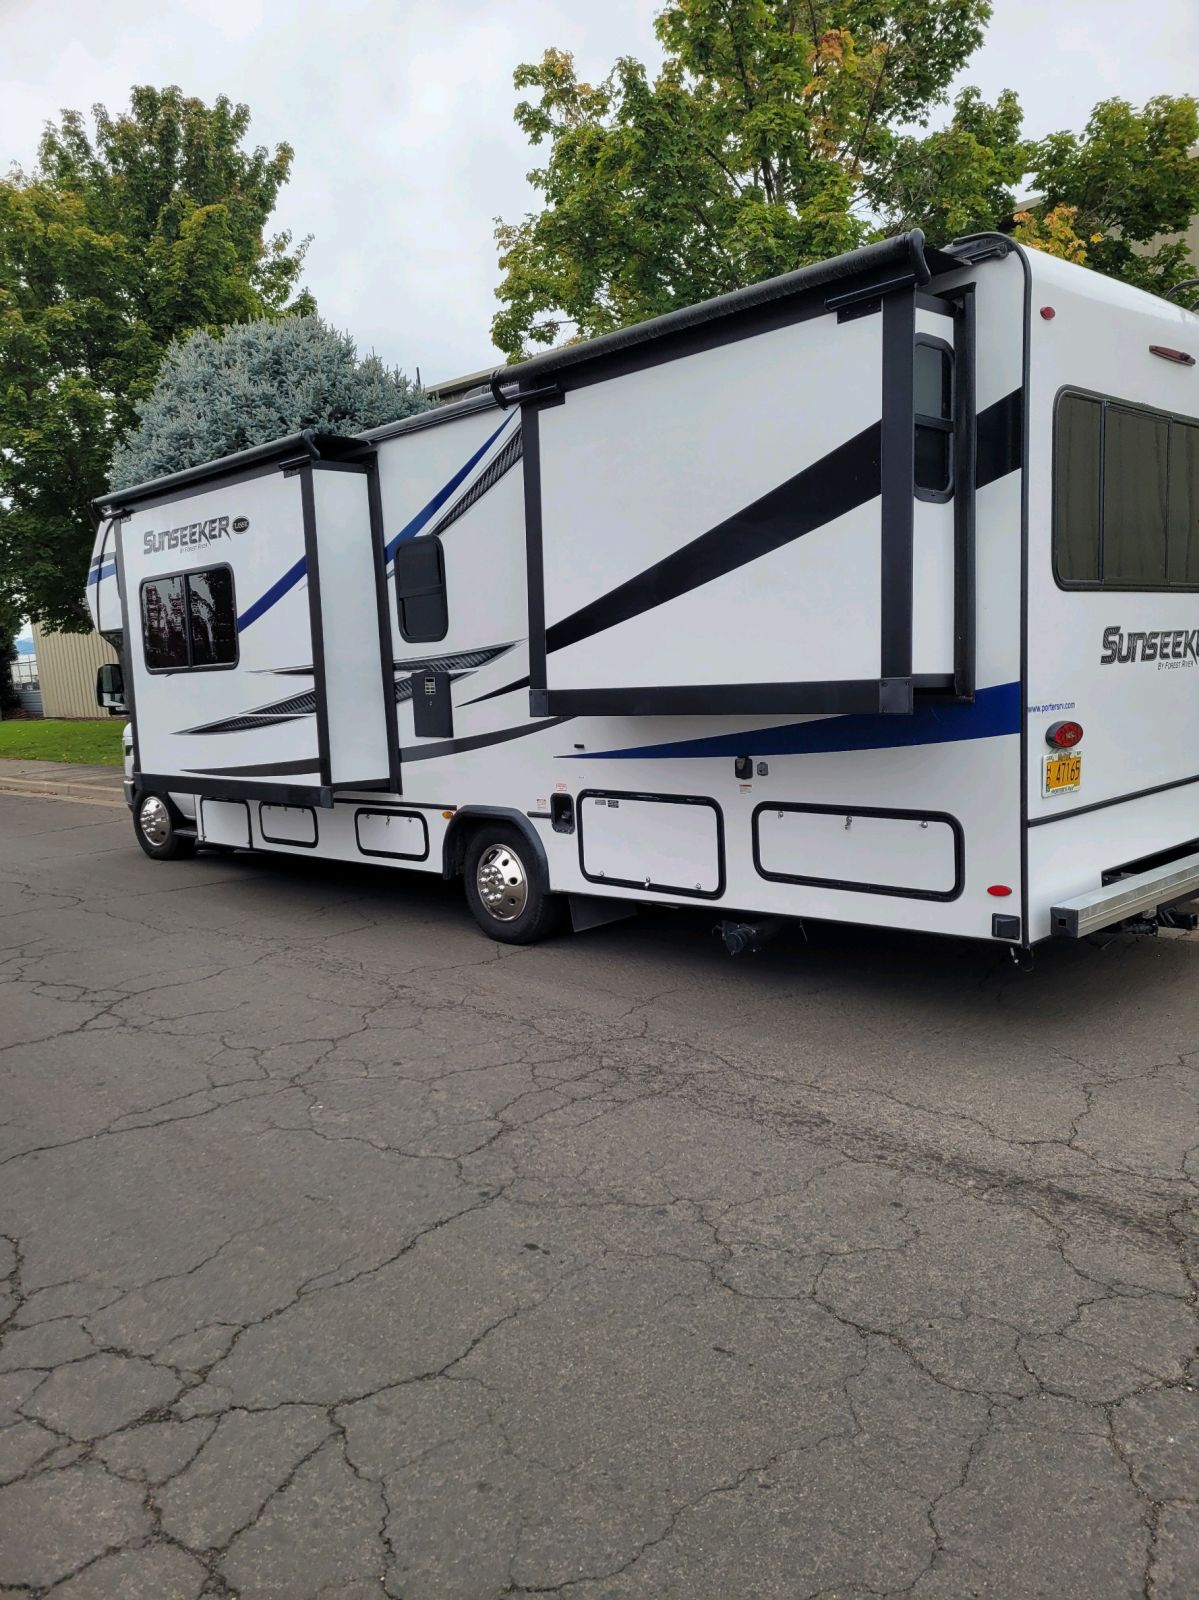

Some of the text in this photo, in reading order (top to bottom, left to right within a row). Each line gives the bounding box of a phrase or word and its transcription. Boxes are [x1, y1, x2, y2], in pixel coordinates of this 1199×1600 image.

[1100, 626, 1199, 665] SUNSEEK
[1158, 660, 1194, 670] BY FOREST RIVER
